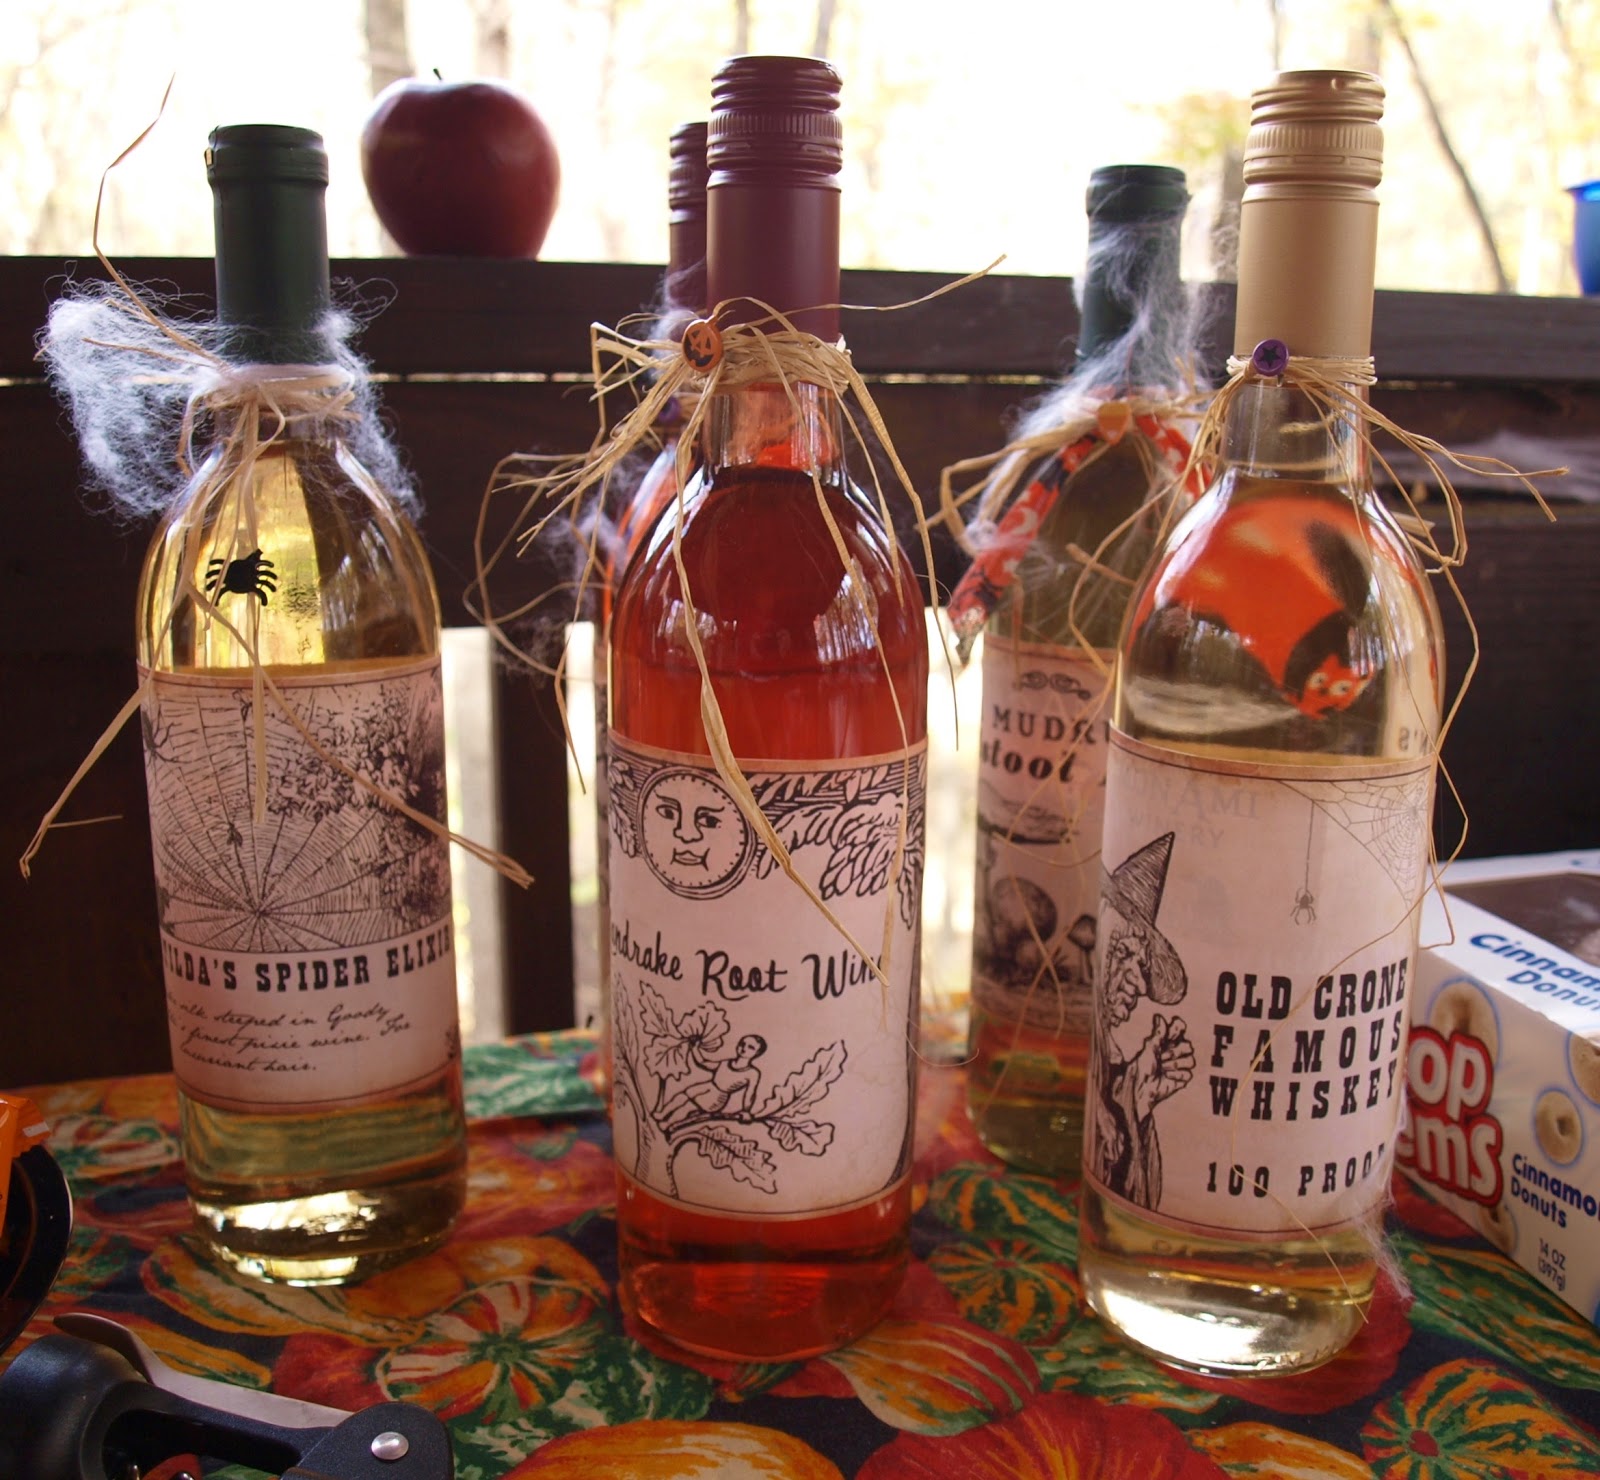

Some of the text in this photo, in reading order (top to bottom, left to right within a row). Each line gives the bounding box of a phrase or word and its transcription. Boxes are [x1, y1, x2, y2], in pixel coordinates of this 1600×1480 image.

[256, 955, 370, 992] SPIDER
[696, 949, 788, 1001] Root
[1216, 957, 1408, 1020] OLD CRONE
[1507, 969, 1600, 1011] Donu
[214, 1009, 287, 1036] steeped
[291, 1010, 317, 1027] in
[327, 1002, 392, 1031] Goody
[1211, 1009, 1402, 1073] FAMOUS
[1209, 1058, 1397, 1121] WHISKEY
[1207, 1162, 1270, 1198] 100
[1511, 1177, 1567, 1228] Donuts
[1513, 1153, 1600, 1221] Cinnamo
[1539, 1237, 1549, 1257] 14
